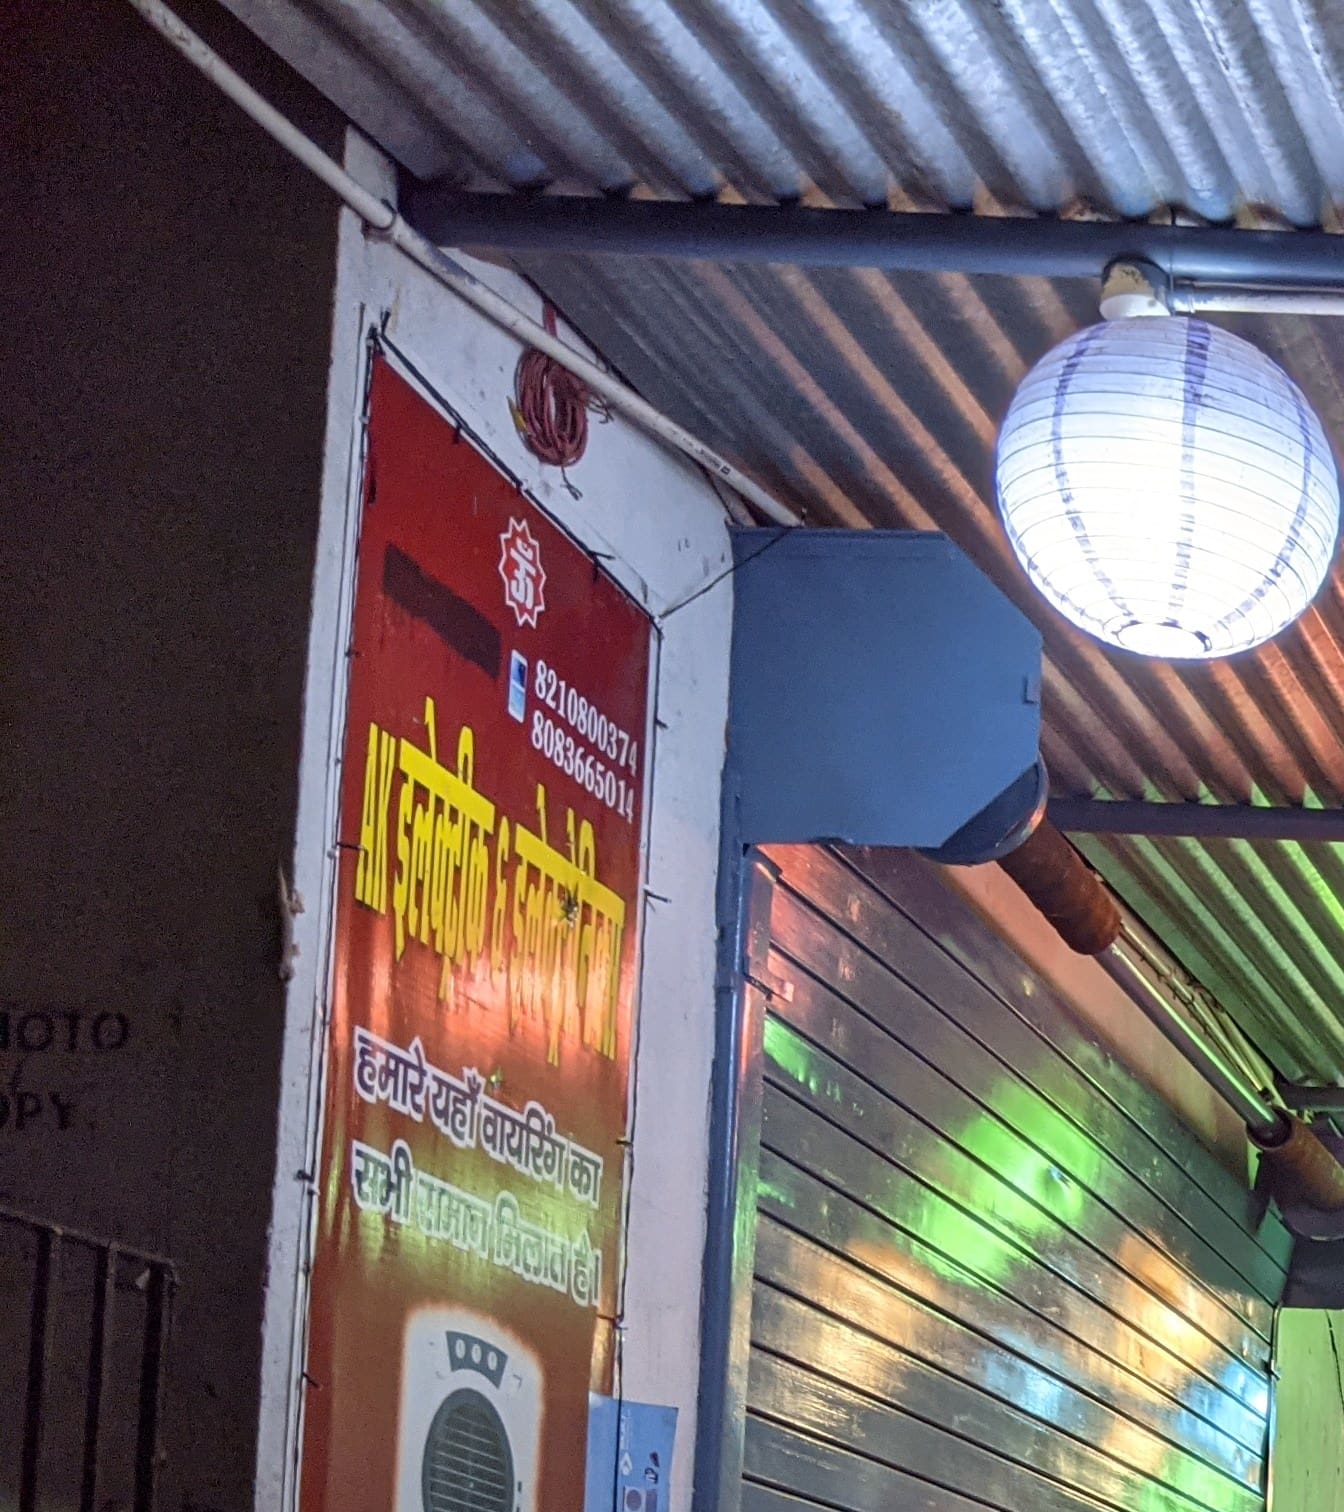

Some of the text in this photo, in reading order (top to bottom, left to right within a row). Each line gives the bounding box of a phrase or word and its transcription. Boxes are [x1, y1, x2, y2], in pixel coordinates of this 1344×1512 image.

[531, 710, 634, 824] 8083665014
[534, 659, 638, 776] 8210800374
[355, 722, 396, 915] AK
[0, 1010, 129, 1051] OTO
[354, 1027, 427, 1122] हमारे
[424, 1067, 481, 1147] यहाँ
[566, 1146, 602, 1203] का
[353, 1140, 416, 1225] सभी
